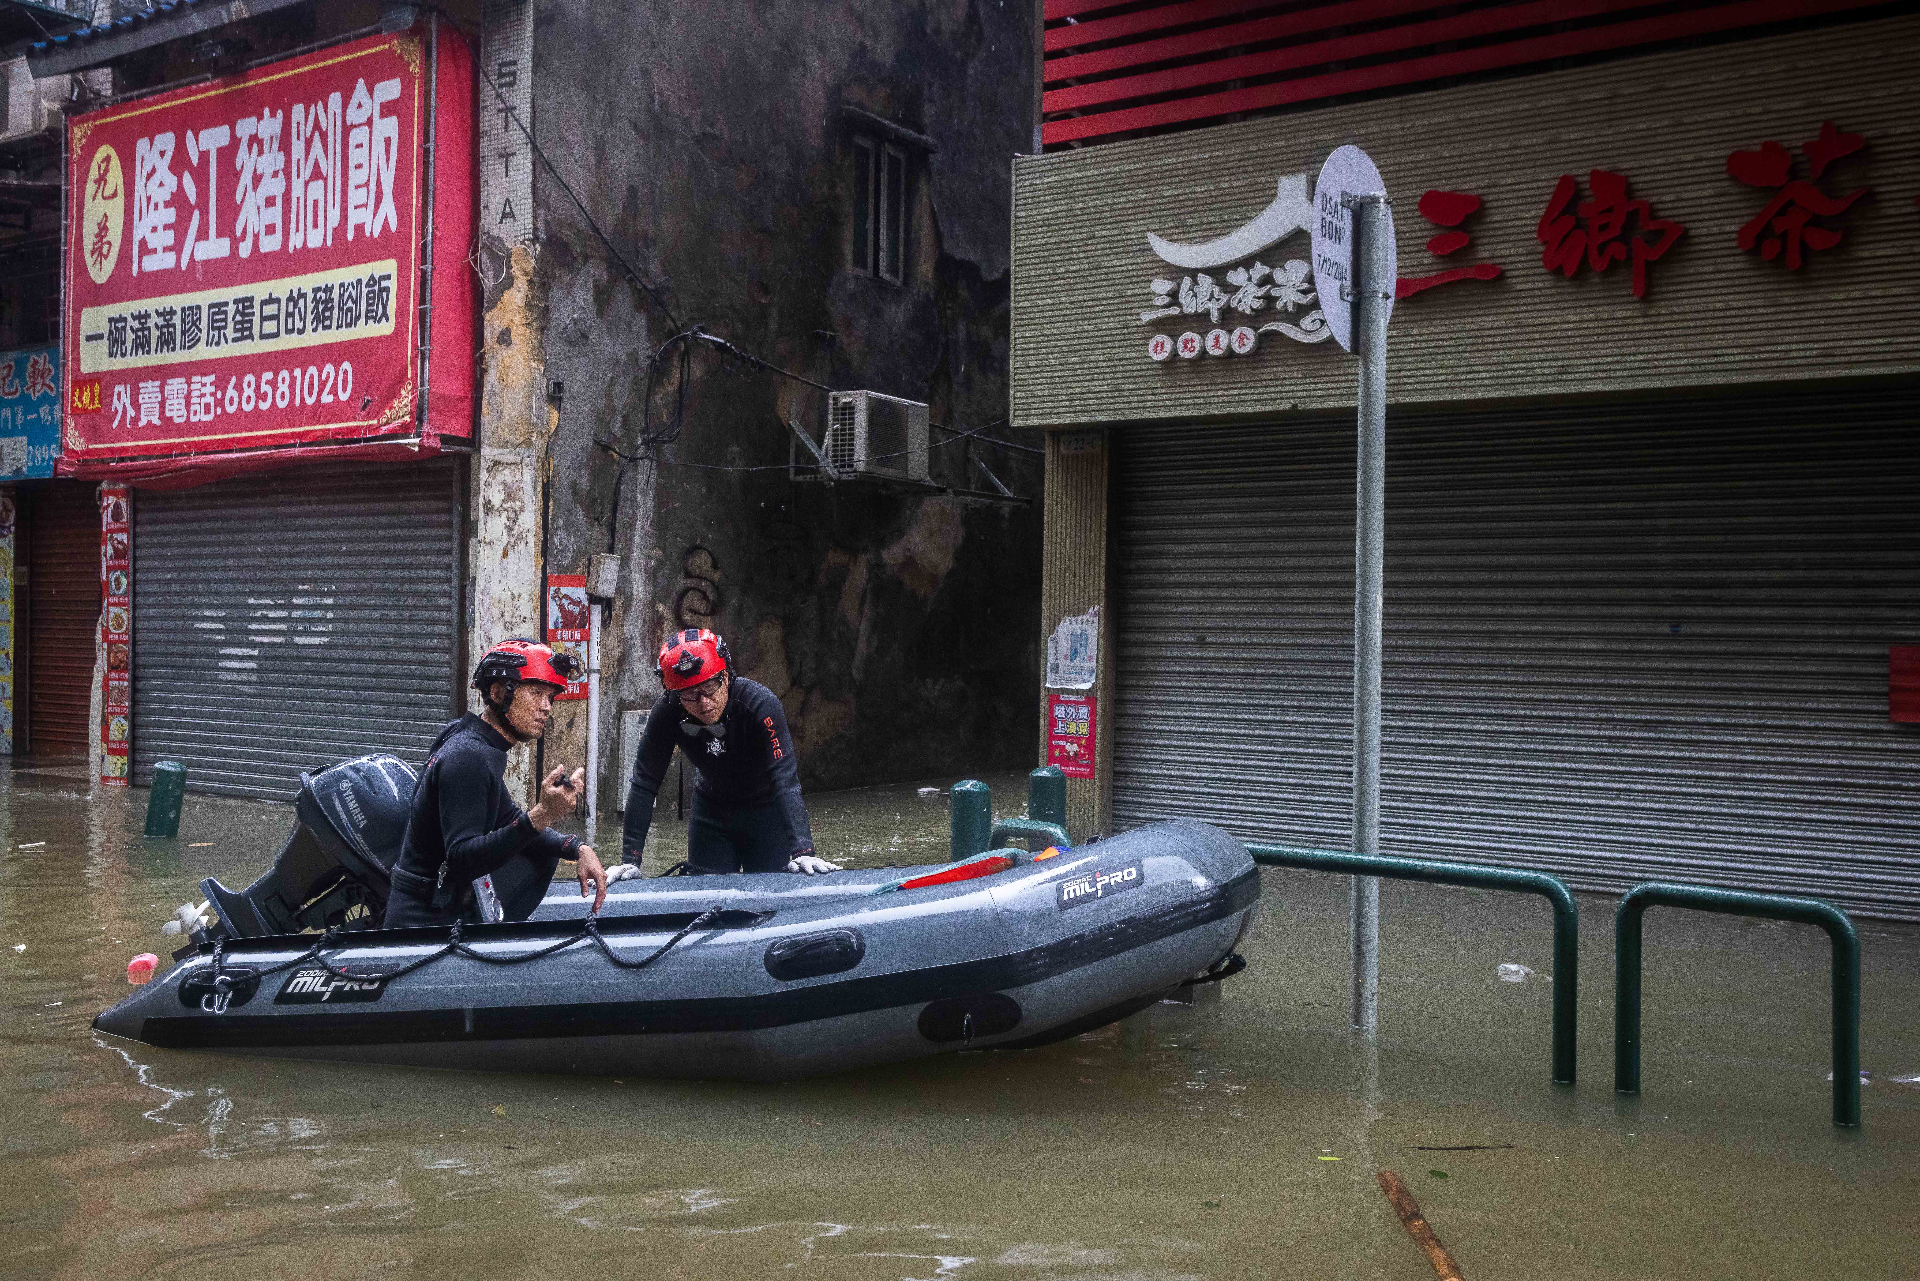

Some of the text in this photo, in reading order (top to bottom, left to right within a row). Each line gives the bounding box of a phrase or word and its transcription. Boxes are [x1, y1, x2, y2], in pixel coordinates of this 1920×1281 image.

[132, 78, 402, 277] 隆江豬腳飯
[91, 153, 118, 272] 兄弟
[85, 273, 392, 360] 一碗滿滿膠原蛋白的豬腳飯
[1140, 259, 1318, 324] 三鄉茶果
[763, 716, 783, 760] BARE
[342, 783, 368, 829] YAMAHA
[1063, 867, 1136, 900] MILPRO
